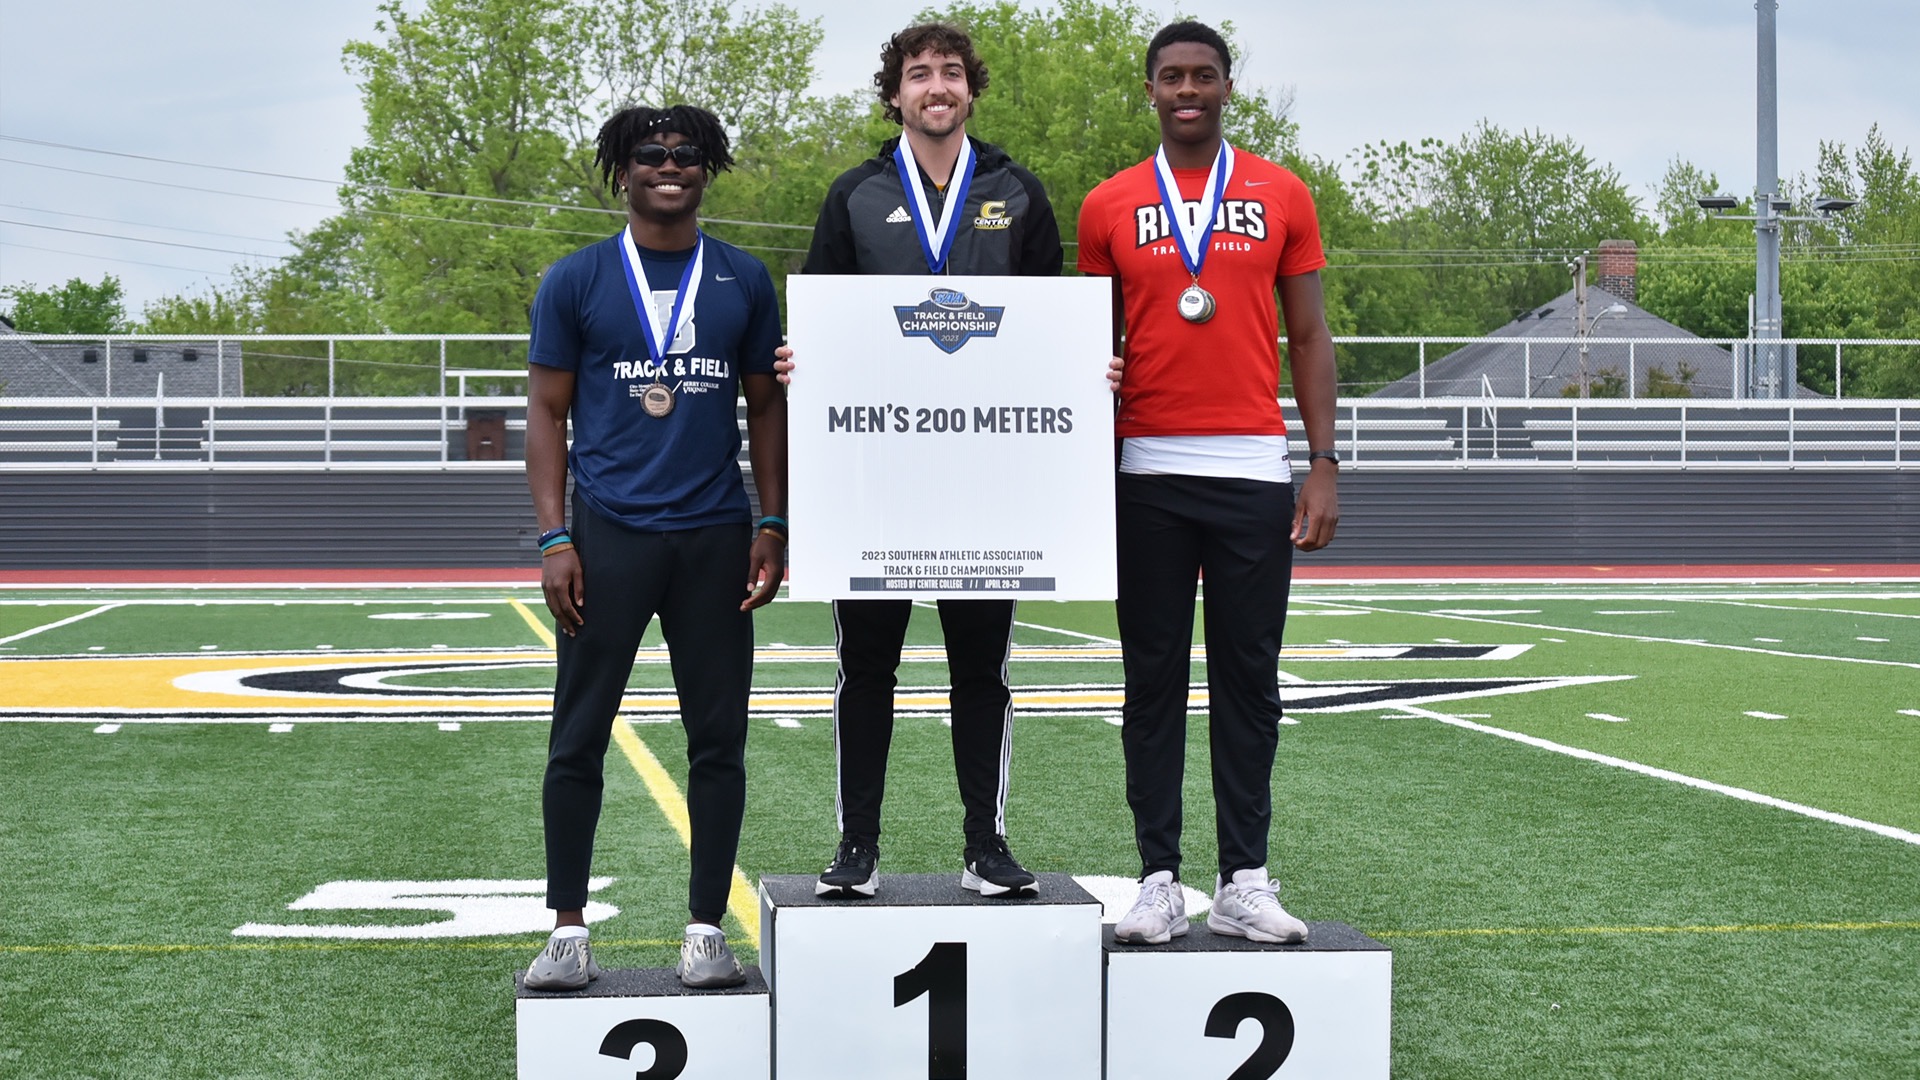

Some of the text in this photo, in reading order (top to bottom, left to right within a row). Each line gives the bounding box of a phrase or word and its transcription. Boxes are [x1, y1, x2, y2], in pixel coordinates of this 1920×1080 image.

[885, 215, 912, 223] adidas
[974, 217, 1009, 225] CENTRE
[1214, 241, 1251, 252] FIELD
[913, 312, 985, 320] TRACK & FIELD
[902, 321, 997, 331] CHAMPIONSHIP
[940, 334, 960, 342] 2023
[673, 358, 686, 376] &
[916, 407, 966, 433] 200
[973, 406, 1073, 433] METERS
[861, 550, 1043, 561] 2023 SOUTHERN ATHLETIC ASSOCIATION
[883, 565, 1024, 576] TRACK & FIELD CHAMPIONSHIP
[886, 579, 908, 589] HOSTED
[908, 579, 917, 589] BY
[917, 579, 939, 589] CENTRE
[939, 579, 964, 589] COLLEGE
[985, 579, 1001, 589] APRIL
[893, 941, 967, 1080] 1
[1204, 991, 1296, 1080] 2
